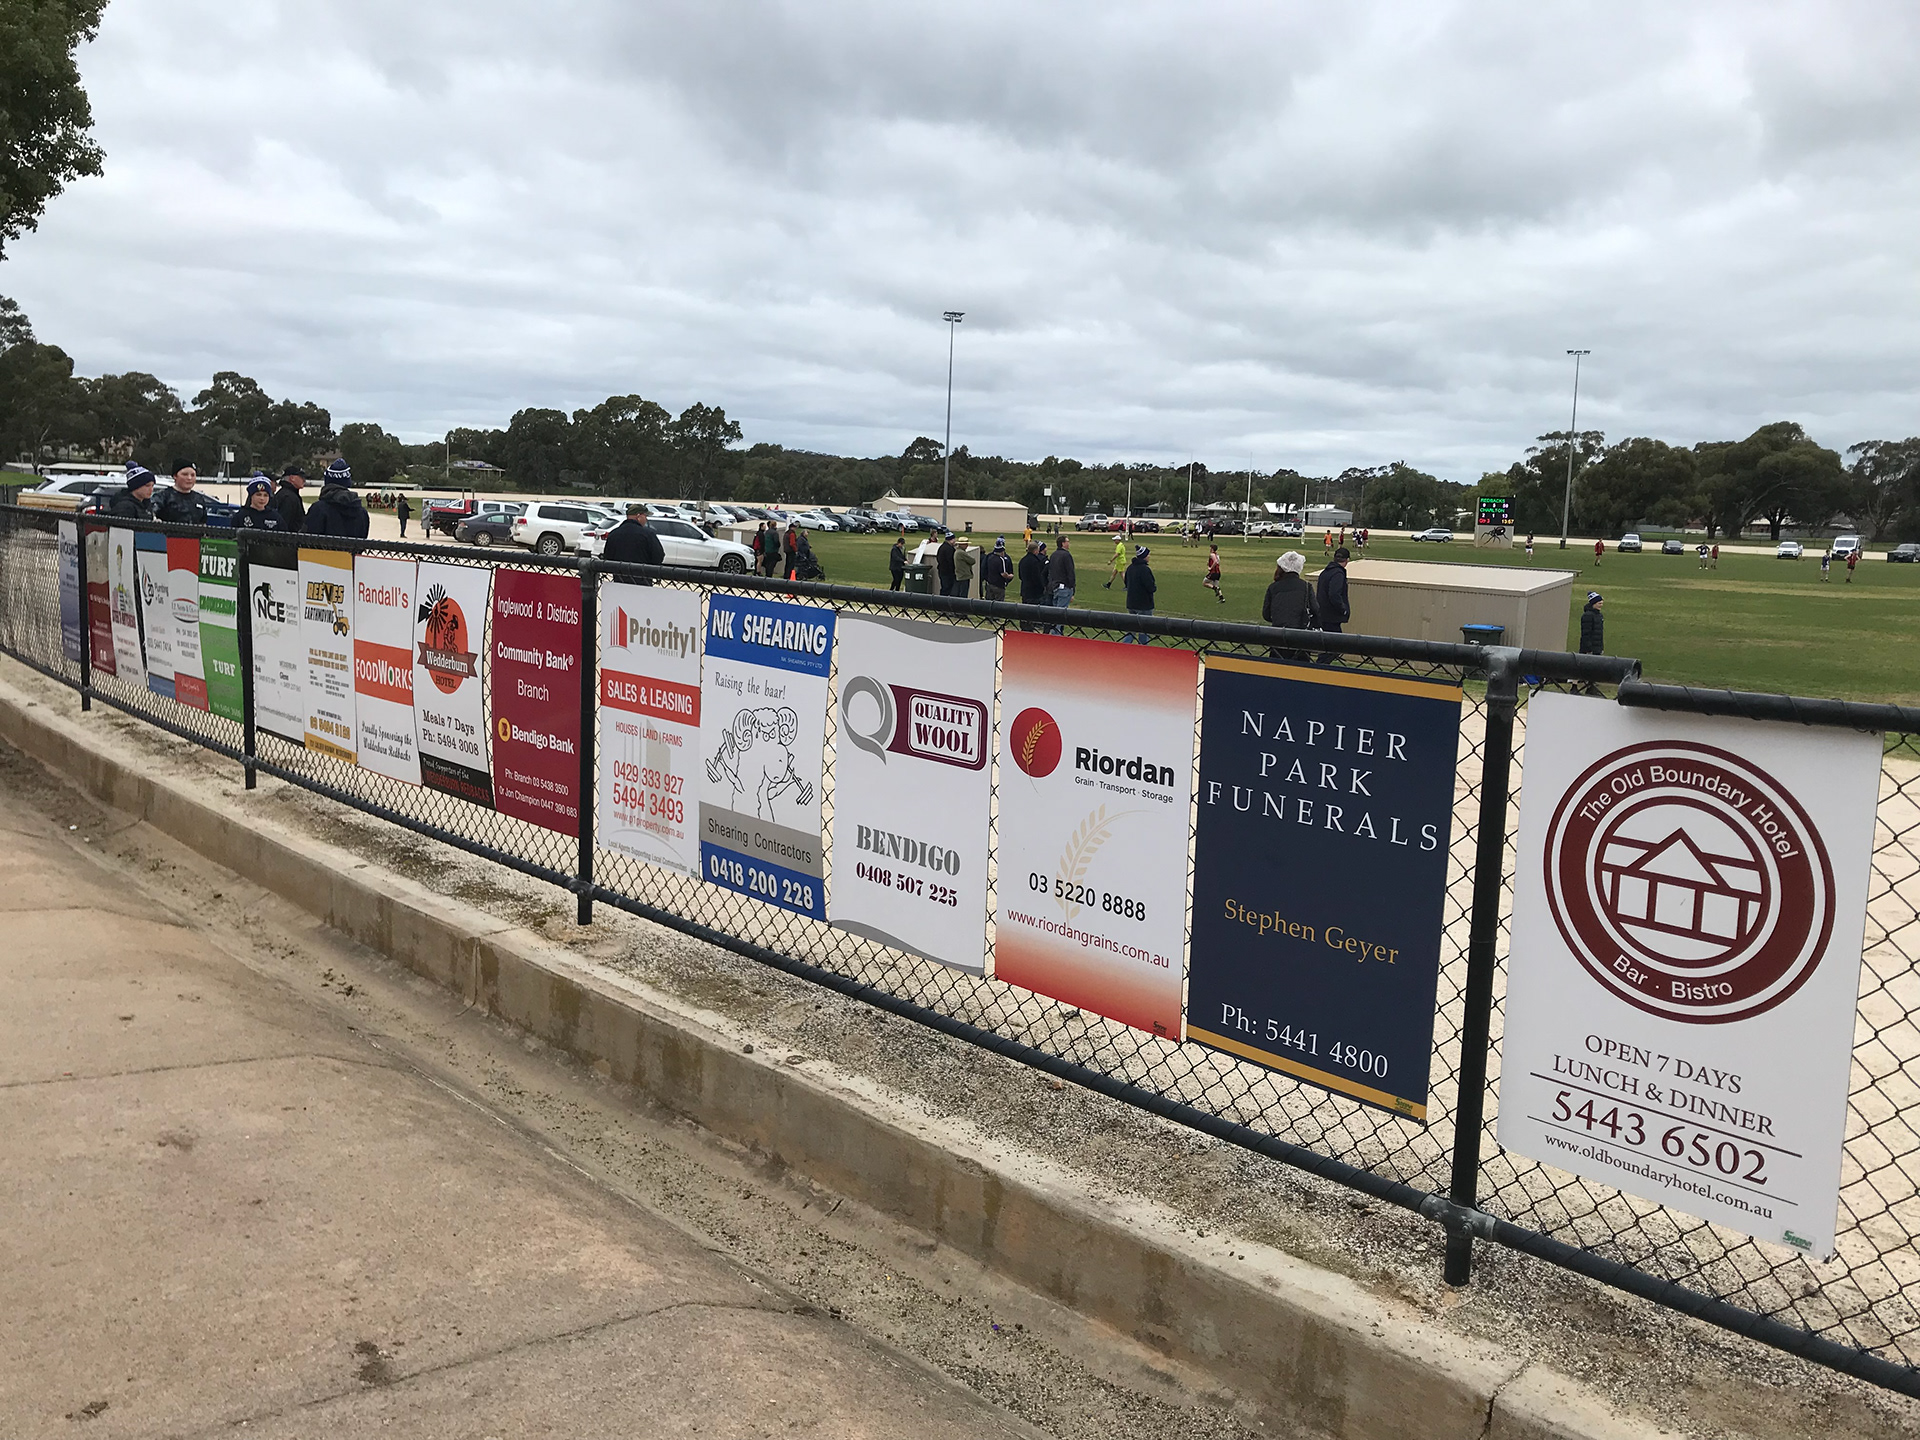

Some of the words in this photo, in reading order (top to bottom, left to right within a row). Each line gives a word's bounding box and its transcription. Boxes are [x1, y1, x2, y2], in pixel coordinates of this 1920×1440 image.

[201, 554, 236, 578] TURF
[306, 581, 344, 604] REEVES
[358, 582, 408, 609] Randall's
[258, 598, 286, 622] NCE
[304, 606, 334, 624] EARTHMOVING
[498, 596, 534, 618] Inglewood
[536, 602, 542, 620] &
[547, 603, 578, 625] Districts
[630, 618, 696, 659] Priority1
[711, 609, 736, 640] NK
[742, 614, 828, 656] SHEARING
[426, 650, 468, 674] Wedderburn
[498, 642, 544, 670] Community
[658, 648, 678, 658] PROPERTY
[788, 658, 806, 666] SHEARING
[212, 659, 236, 678] TURF
[356, 658, 413, 690] FOODWORKS
[435, 675, 456, 688] HOTEL
[518, 679, 549, 702] Branch
[608, 680, 638, 702] SALES
[640, 686, 648, 705] &
[650, 688, 692, 715] LEASING
[715, 672, 743, 696] Raising
[748, 676, 760, 694] the
[764, 680, 786, 700] baar!
[422, 710, 446, 727] Meals
[446, 716, 453, 729] 7
[455, 718, 475, 737] Days
[914, 702, 975, 727] QUALITY
[362, 720, 378, 739] Proudly
[378, 726, 403, 746] Sponsoring
[404, 734, 412, 746] the
[422, 728, 436, 744] Ph:
[437, 733, 457, 750] 5494
[458, 739, 480, 756] 3008
[512, 724, 548, 750] Bendigo
[550, 734, 574, 754] Bank
[616, 722, 638, 737] HOUSES
[642, 728, 658, 741] LAND
[662, 732, 682, 748] FARMS
[914, 722, 973, 756] WOOL
[1241, 710, 1408, 762] NAPIER
[364, 737, 388, 755] Wedderburn
[388, 745, 410, 762] Redbacks
[614, 760, 638, 783] 0429
[642, 768, 660, 790] 333
[664, 774, 684, 796] 927
[1076, 747, 1174, 787] Riordan
[1259, 752, 1373, 797] PARK
[460, 781, 490, 802] REDBACKS
[505, 768, 514, 780] Ph:
[514, 771, 532, 785] Branch
[532, 777, 540, 787] 03
[540, 779, 554, 792] 5438
[555, 783, 568, 796] 3500
[1074, 776, 1094, 788] Grain
[1099, 781, 1136, 796] Transport
[1142, 789, 1174, 804] Storage
[505, 788, 514, 799] Jon
[514, 790, 540, 807] Champion
[540, 799, 554, 810] 0447
[613, 783, 645, 812] 5494
[650, 793, 684, 824] 3493
[1580, 791, 1612, 824] The
[1611, 769, 1645, 796] Old
[1650, 765, 1752, 808] Boundary
[1750, 803, 1799, 859] Hotel
[614, 811, 684, 840] www.p1property.com.au
[1207, 780, 1438, 851] FUNERALS
[608, 840, 618, 848] Local
[618, 843, 630, 852] Agents
[631, 846, 651, 861] Supporting
[652, 854, 661, 863] Local
[708, 818, 748, 848] Shearing
[754, 832, 812, 864] Contractors
[856, 824, 960, 876] BENDIGO
[710, 854, 744, 886] 0418
[748, 867, 778, 898] 200
[782, 878, 814, 910] 228
[856, 862, 892, 887] 0408
[896, 873, 924, 896] 507
[929, 884, 958, 908] 225
[1029, 872, 1048, 894] 03
[1055, 879, 1096, 907] 5220
[1102, 892, 1146, 922] 8888
[1008, 908, 1170, 968] www.riordangrains.com.au
[1224, 898, 1316, 942] Stephen
[1324, 926, 1399, 964] Geyer
[1613, 954, 1649, 986] Bar
[1671, 980, 1733, 1000] Bistro
[1220, 1002, 1257, 1035] Ph:
[1265, 1018, 1318, 1056] 5441
[1330, 1041, 1388, 1078] 4800
[1585, 1034, 1651, 1068] OPEN
[1657, 1054, 1670, 1073] 7
[1674, 1058, 1742, 1094] DAYS
[1553, 1054, 1640, 1096] LUNCH
[1645, 1083, 1662, 1103] &
[1668, 1088, 1776, 1138] DINNER
[1552, 1090, 1646, 1146] 5443
[1661, 1125, 1768, 1186] 6502
[1545, 1134, 1773, 1220] www.oldboundaryhotel.com.au
